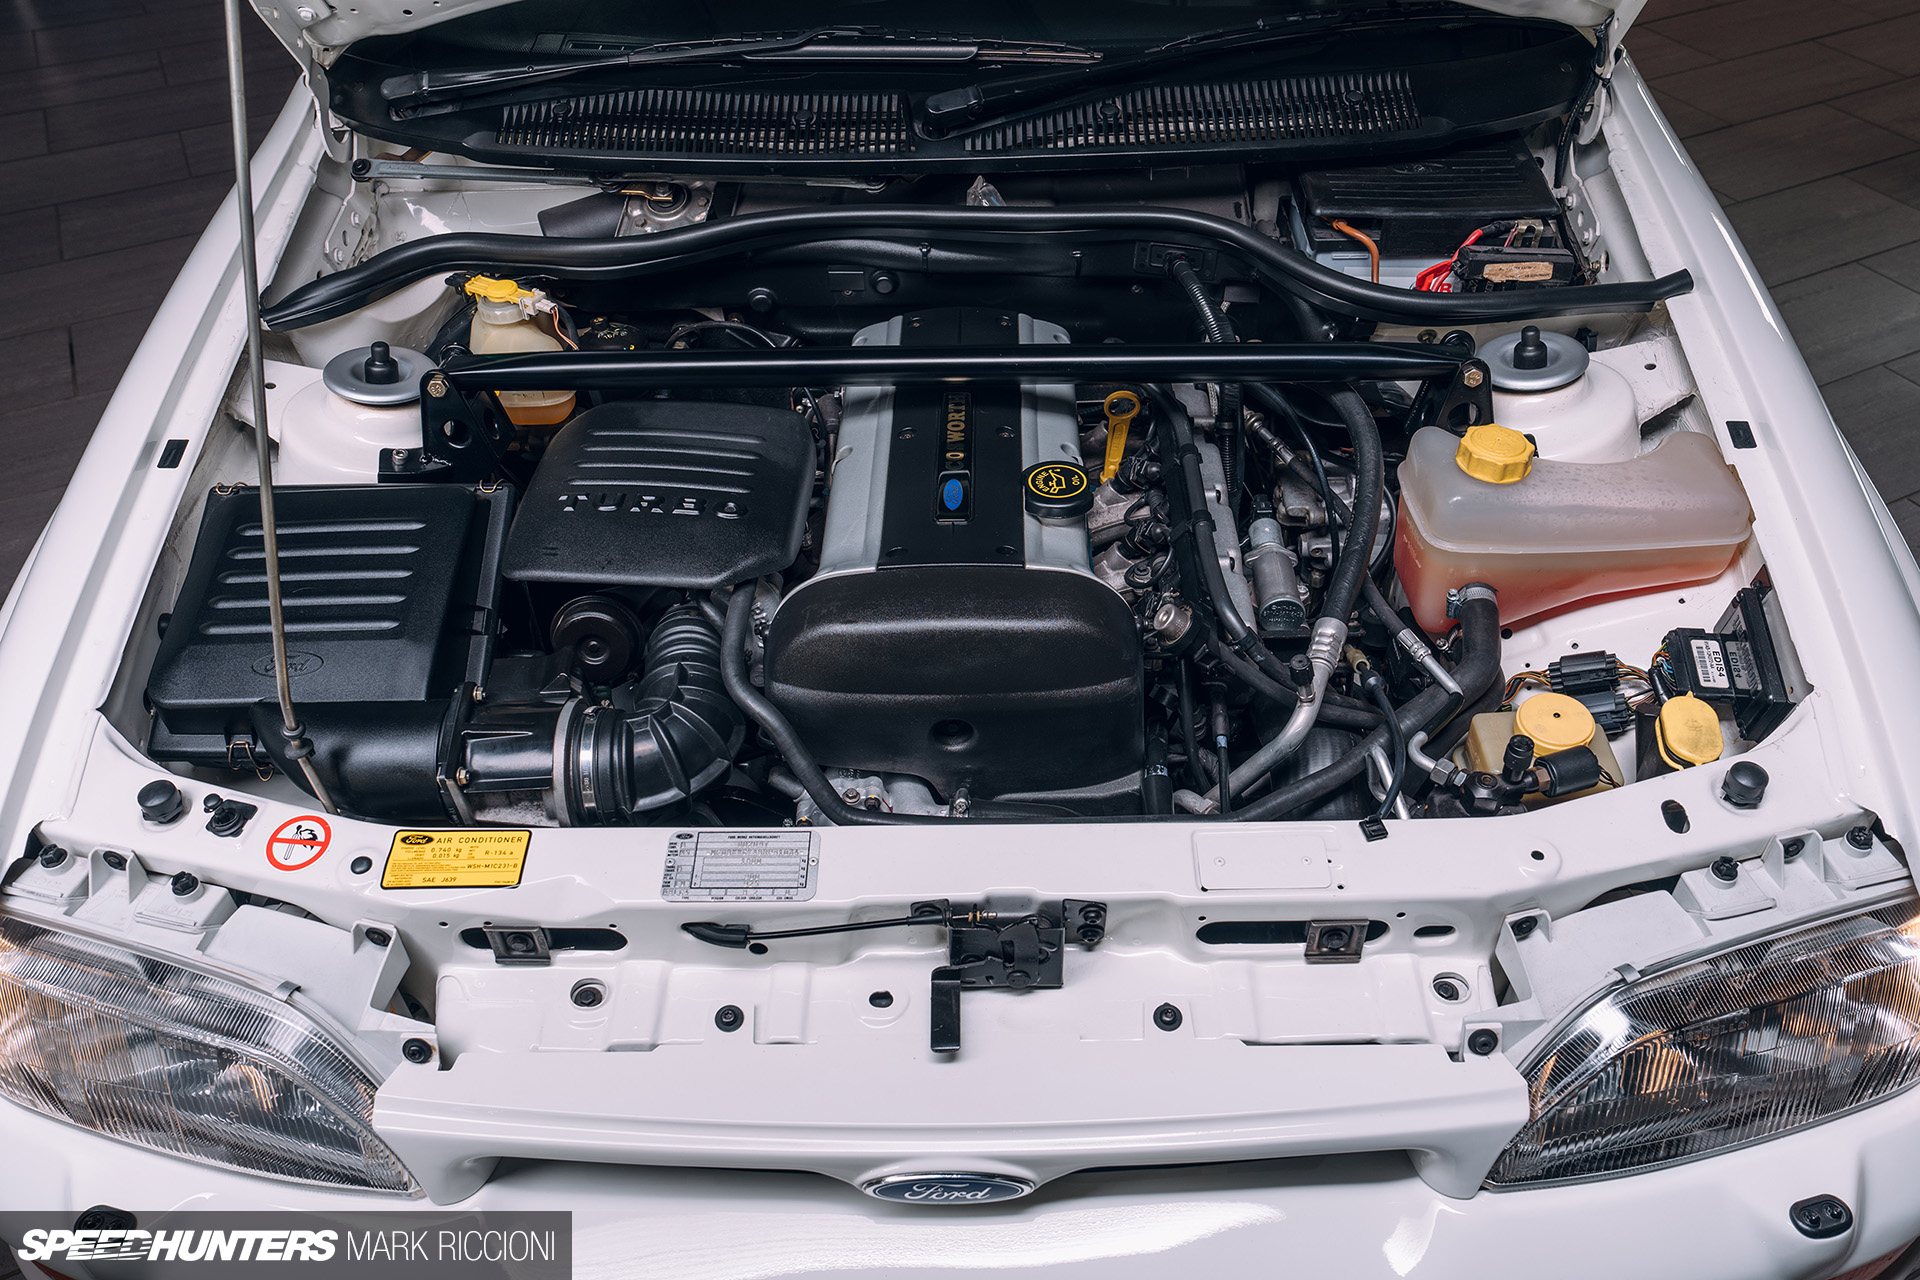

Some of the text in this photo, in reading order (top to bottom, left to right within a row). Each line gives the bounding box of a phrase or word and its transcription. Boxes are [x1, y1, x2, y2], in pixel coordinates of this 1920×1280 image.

[946, 394, 966, 470] COSWORTH
[1036, 471, 1049, 492] ENGINE
[1072, 475, 1080, 486] OIL
[558, 493, 748, 520] TURBO
[265, 656, 311, 673] Frd
[1712, 651, 1726, 678] EDIS4
[404, 834, 430, 845] Ford
[458, 836, 523, 844] CONDITIONER
[904, 1183, 993, 1200] Ford
